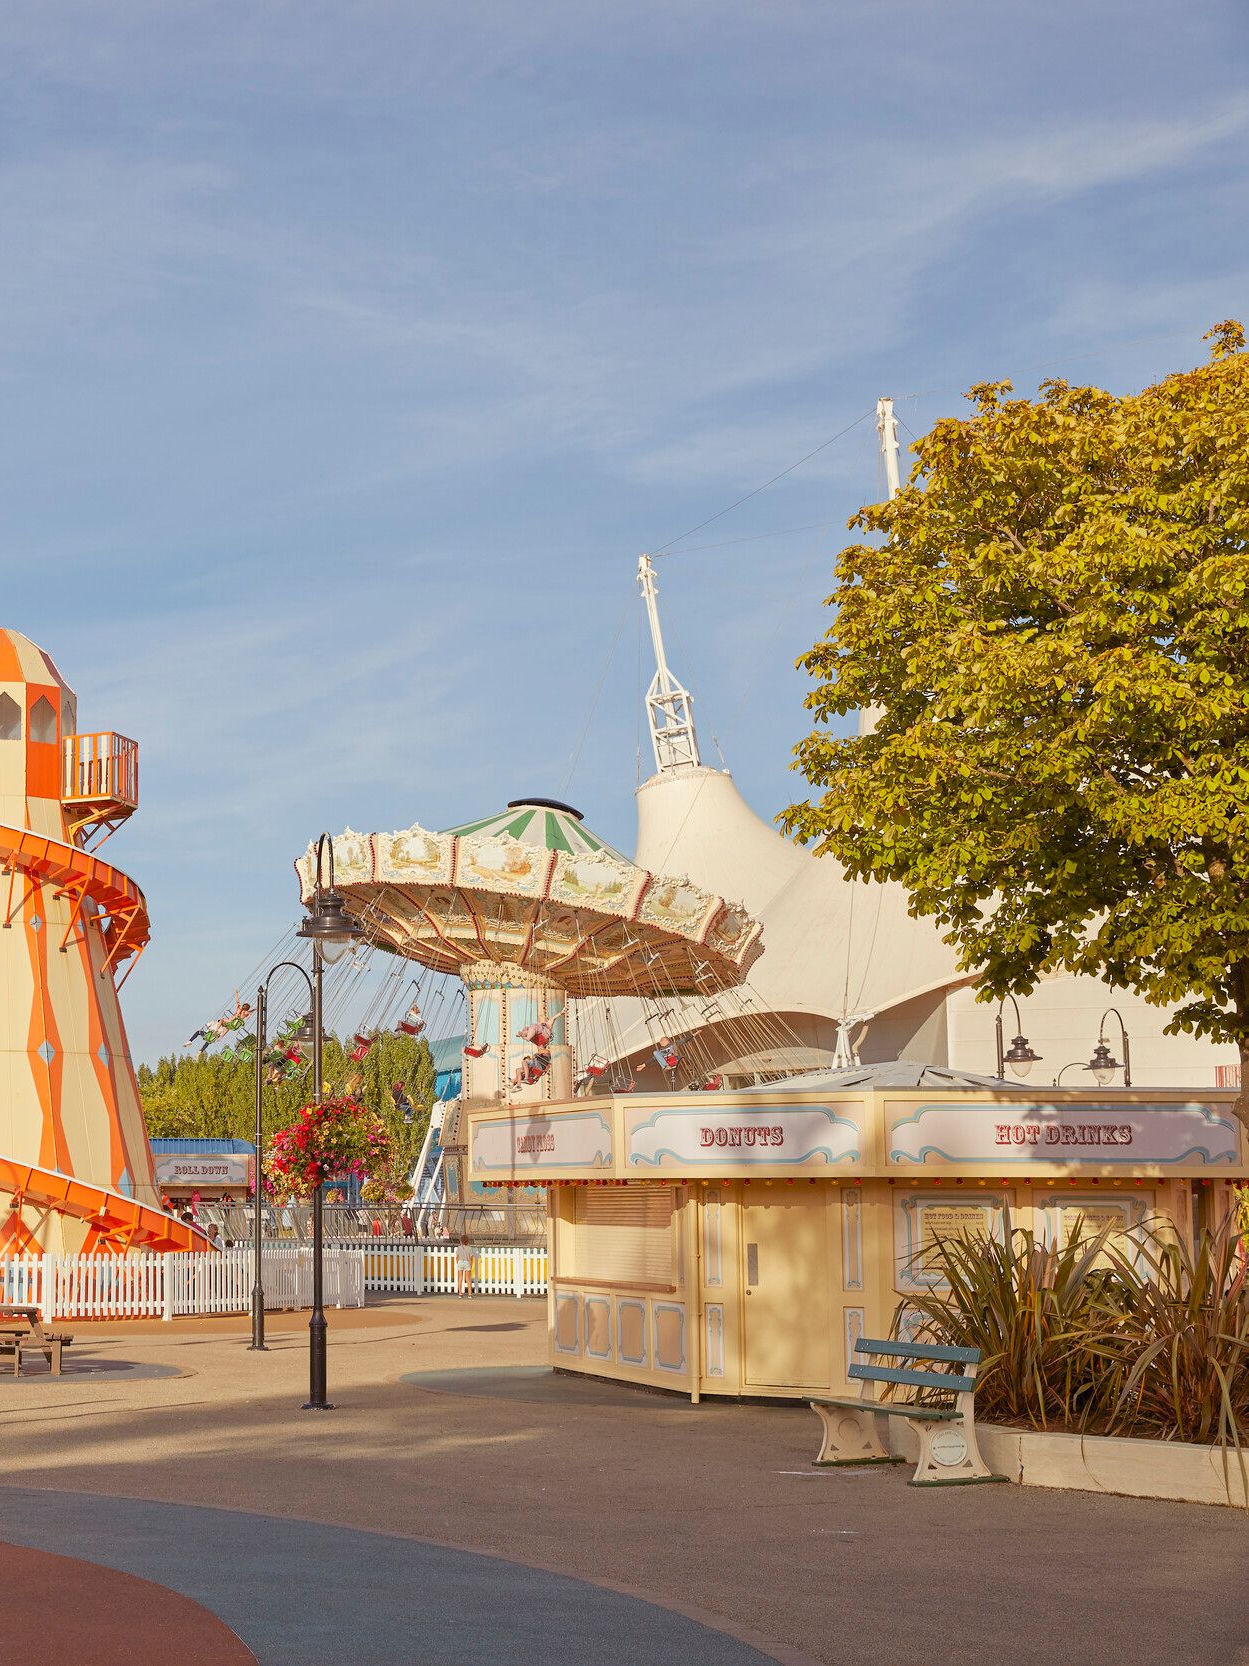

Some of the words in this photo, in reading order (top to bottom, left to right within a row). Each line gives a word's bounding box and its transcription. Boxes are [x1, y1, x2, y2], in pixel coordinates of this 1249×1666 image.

[700, 1126, 784, 1147] DONUTS
[995, 1124, 1040, 1146] HOT
[1045, 1124, 1133, 1146] DRINKS
[174, 1165, 200, 1175] ROLL
[201, 1165, 229, 1175] DOWN
